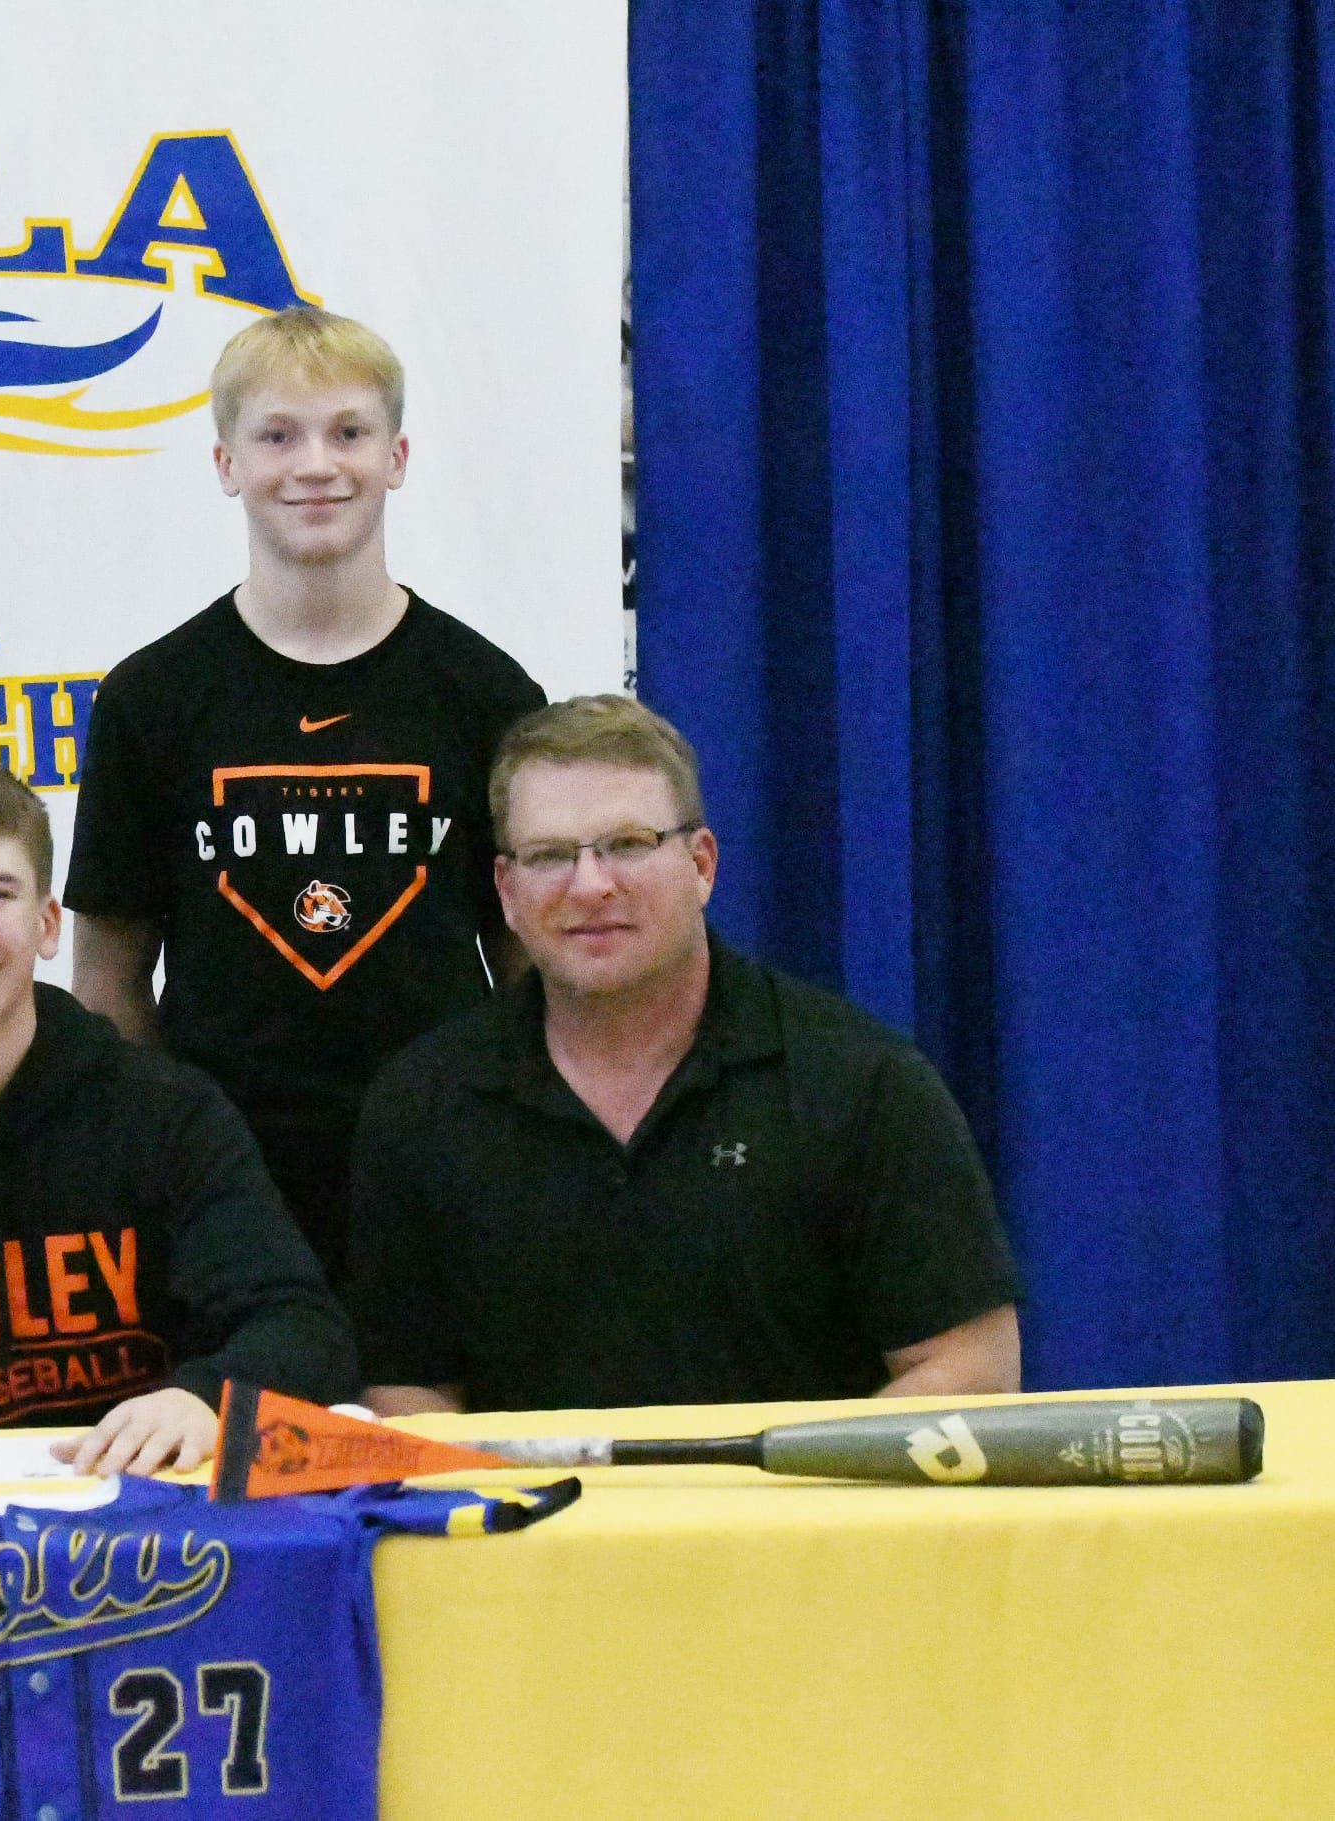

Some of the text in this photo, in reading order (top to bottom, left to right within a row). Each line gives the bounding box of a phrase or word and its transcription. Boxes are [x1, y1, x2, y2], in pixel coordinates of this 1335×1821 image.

[281, 786, 364, 798] TIGERS
[195, 812, 452, 862] COWLEY
[109, 1661, 269, 1801] 27
